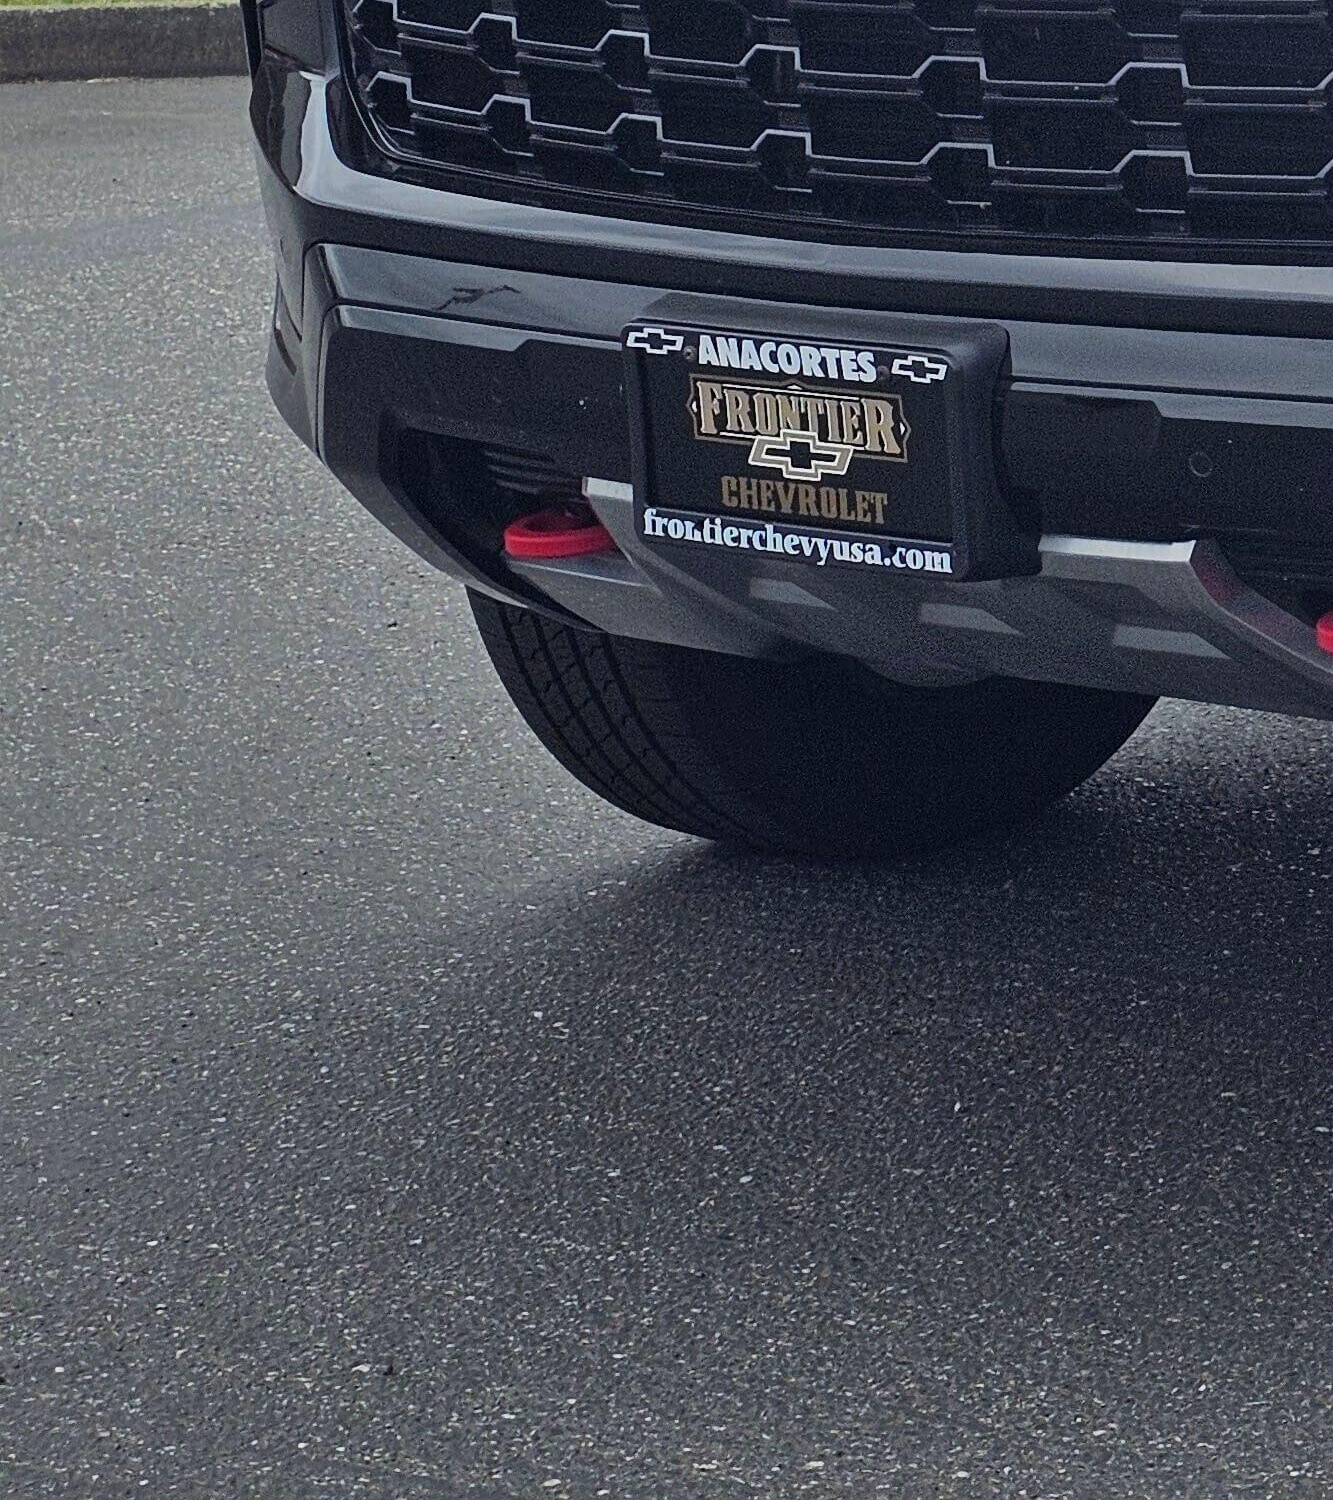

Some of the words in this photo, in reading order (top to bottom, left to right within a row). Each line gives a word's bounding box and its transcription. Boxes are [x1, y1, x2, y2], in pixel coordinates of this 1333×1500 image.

[698, 334, 878, 384] ANACORTES
[696, 380, 901, 455] FRONTIER
[721, 474, 888, 525] CHEVROLET
[643, 509, 953, 574] frontierchevyusa.com
